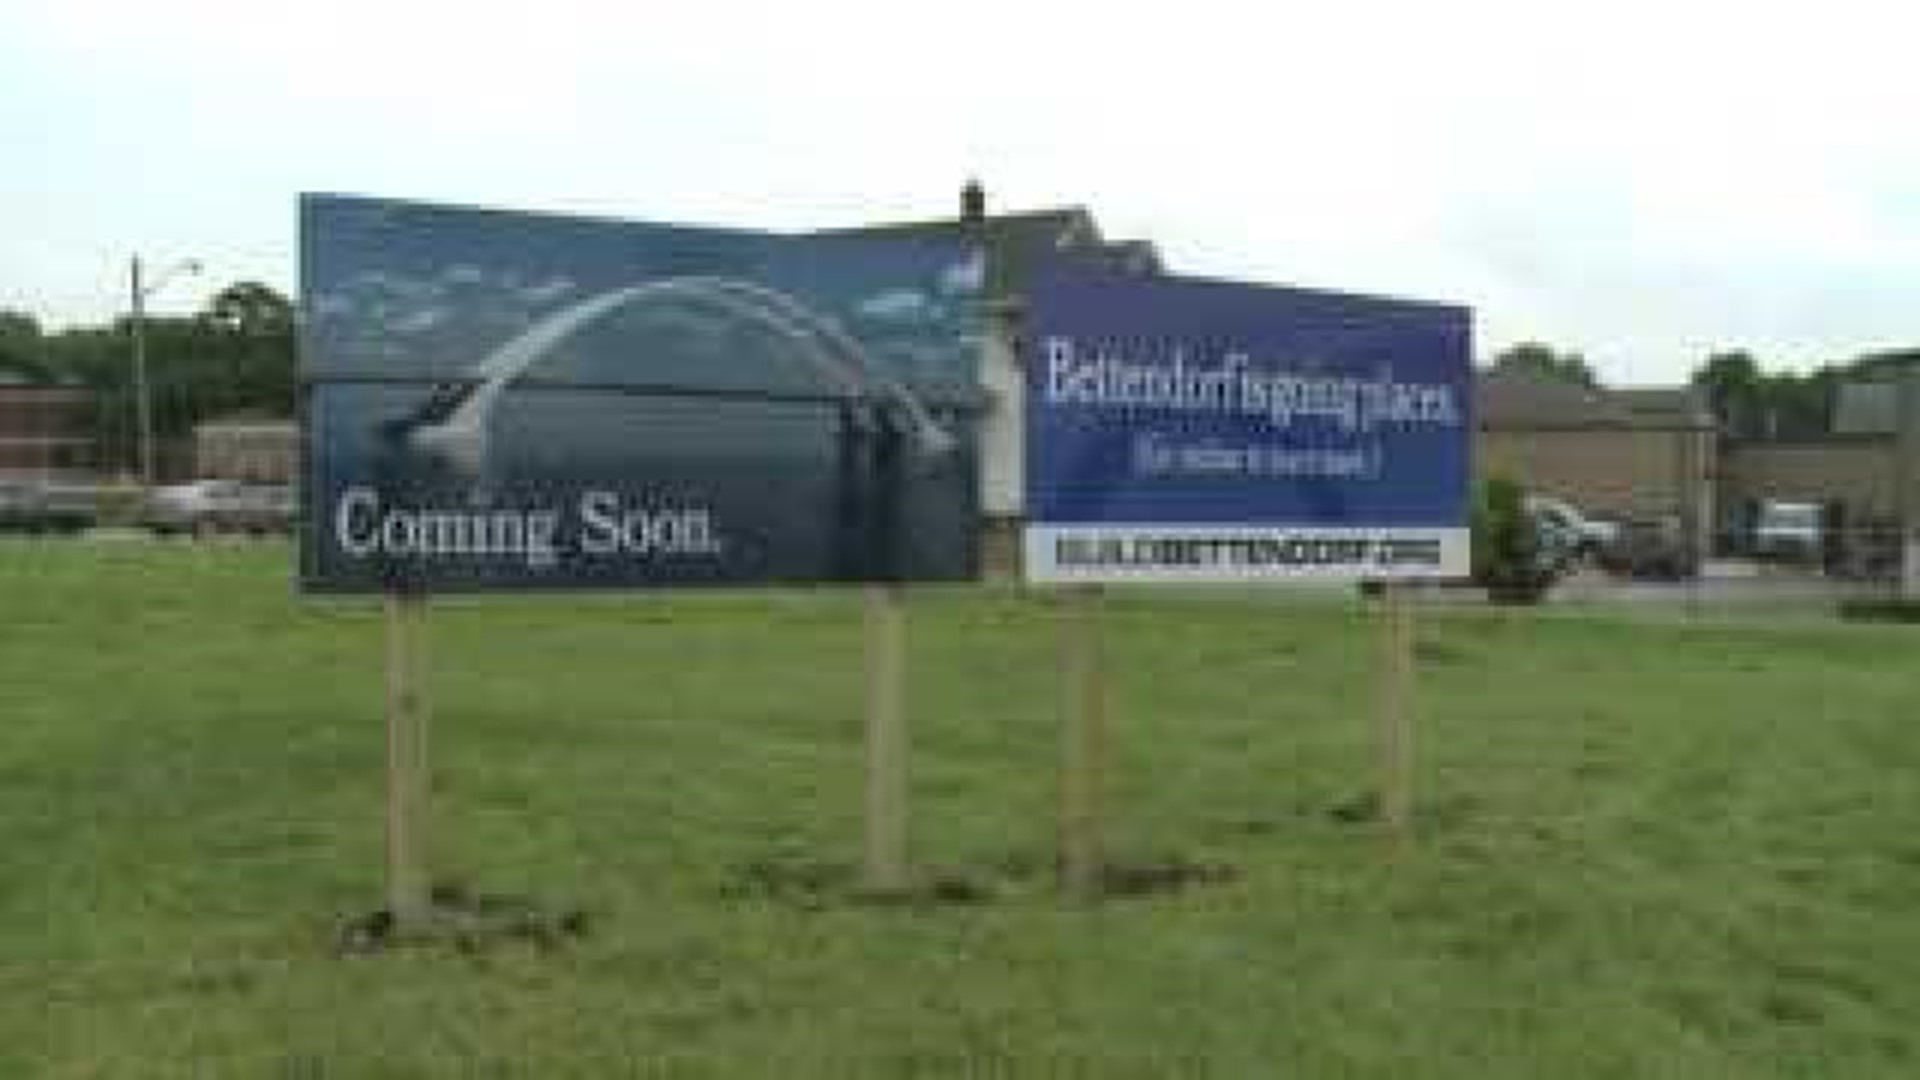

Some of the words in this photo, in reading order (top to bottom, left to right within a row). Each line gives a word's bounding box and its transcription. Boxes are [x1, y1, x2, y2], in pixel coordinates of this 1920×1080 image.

[1049, 338, 1248, 412] Bettendorf
[336, 486, 558, 566] Coming
[581, 490, 722, 554] Soon.
